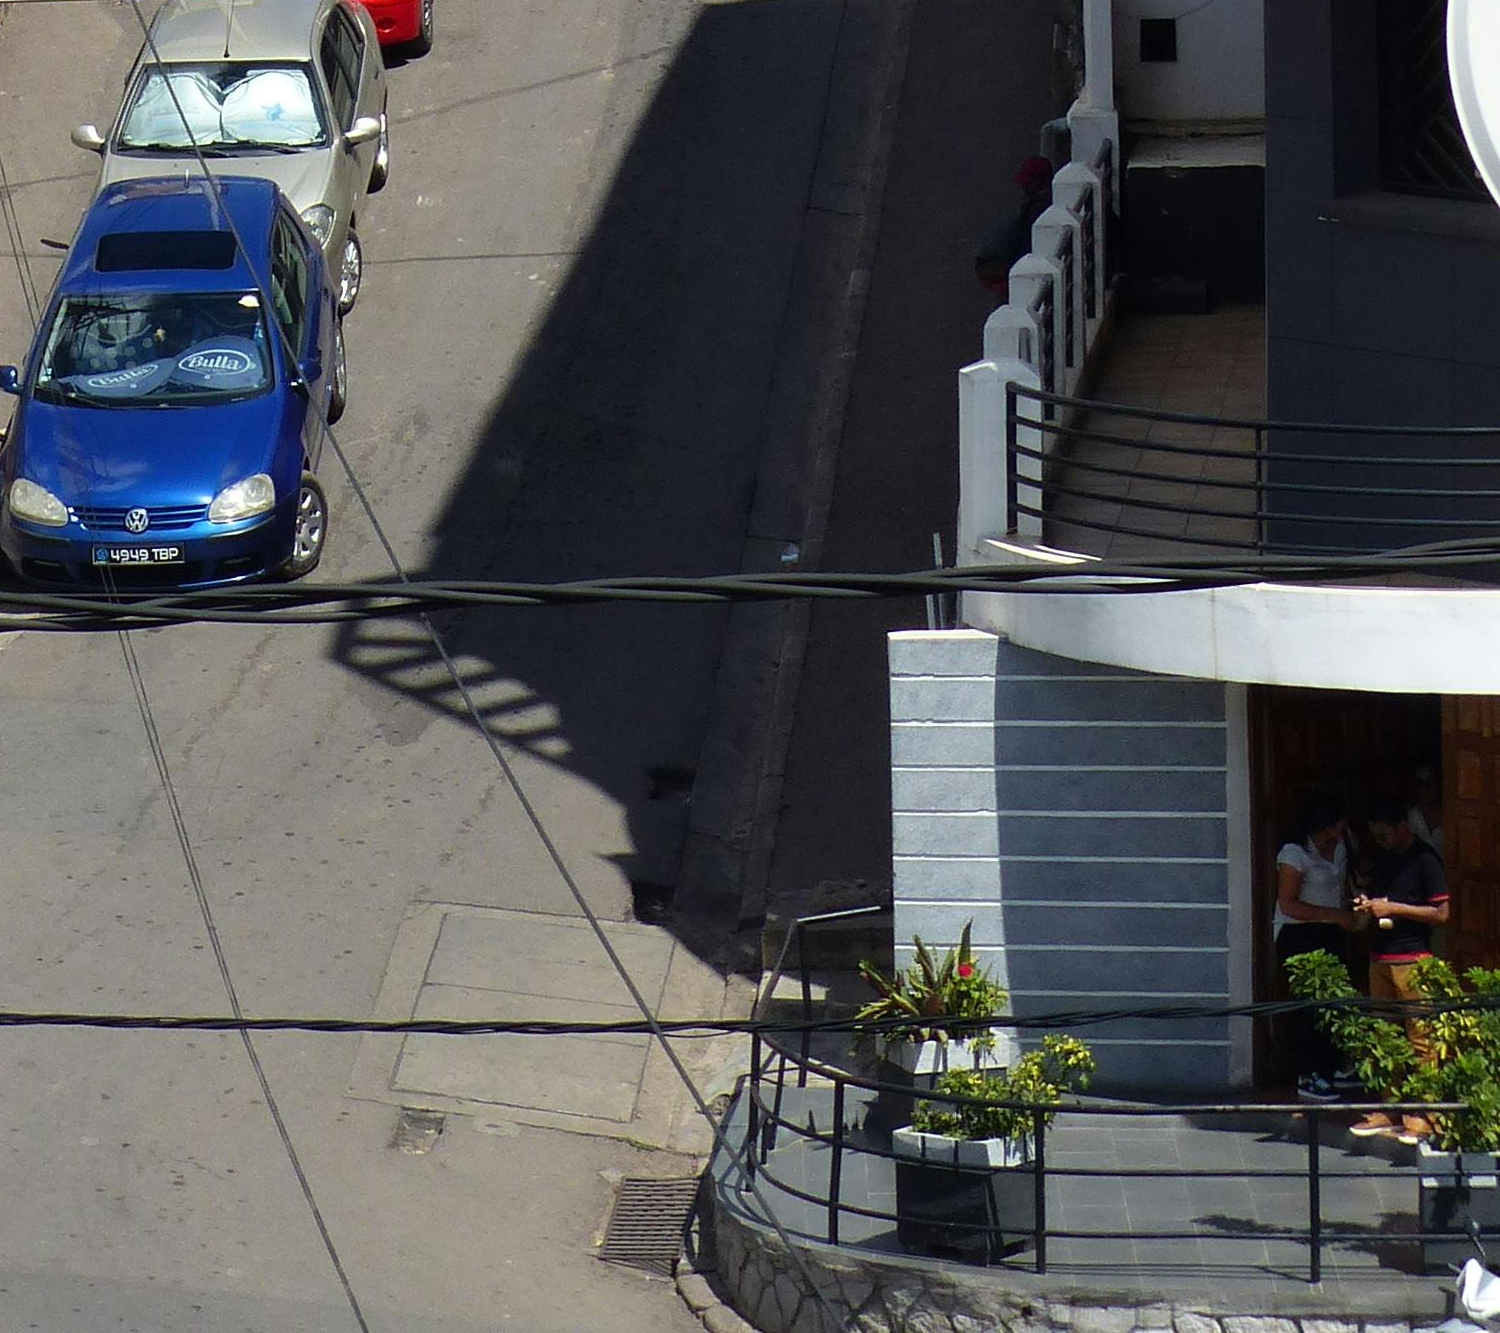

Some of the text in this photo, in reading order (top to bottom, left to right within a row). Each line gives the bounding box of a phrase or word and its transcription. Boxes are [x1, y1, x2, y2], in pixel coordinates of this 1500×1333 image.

[188, 355, 241, 371] Bulla
[111, 547, 179, 562] 4949 TBP
